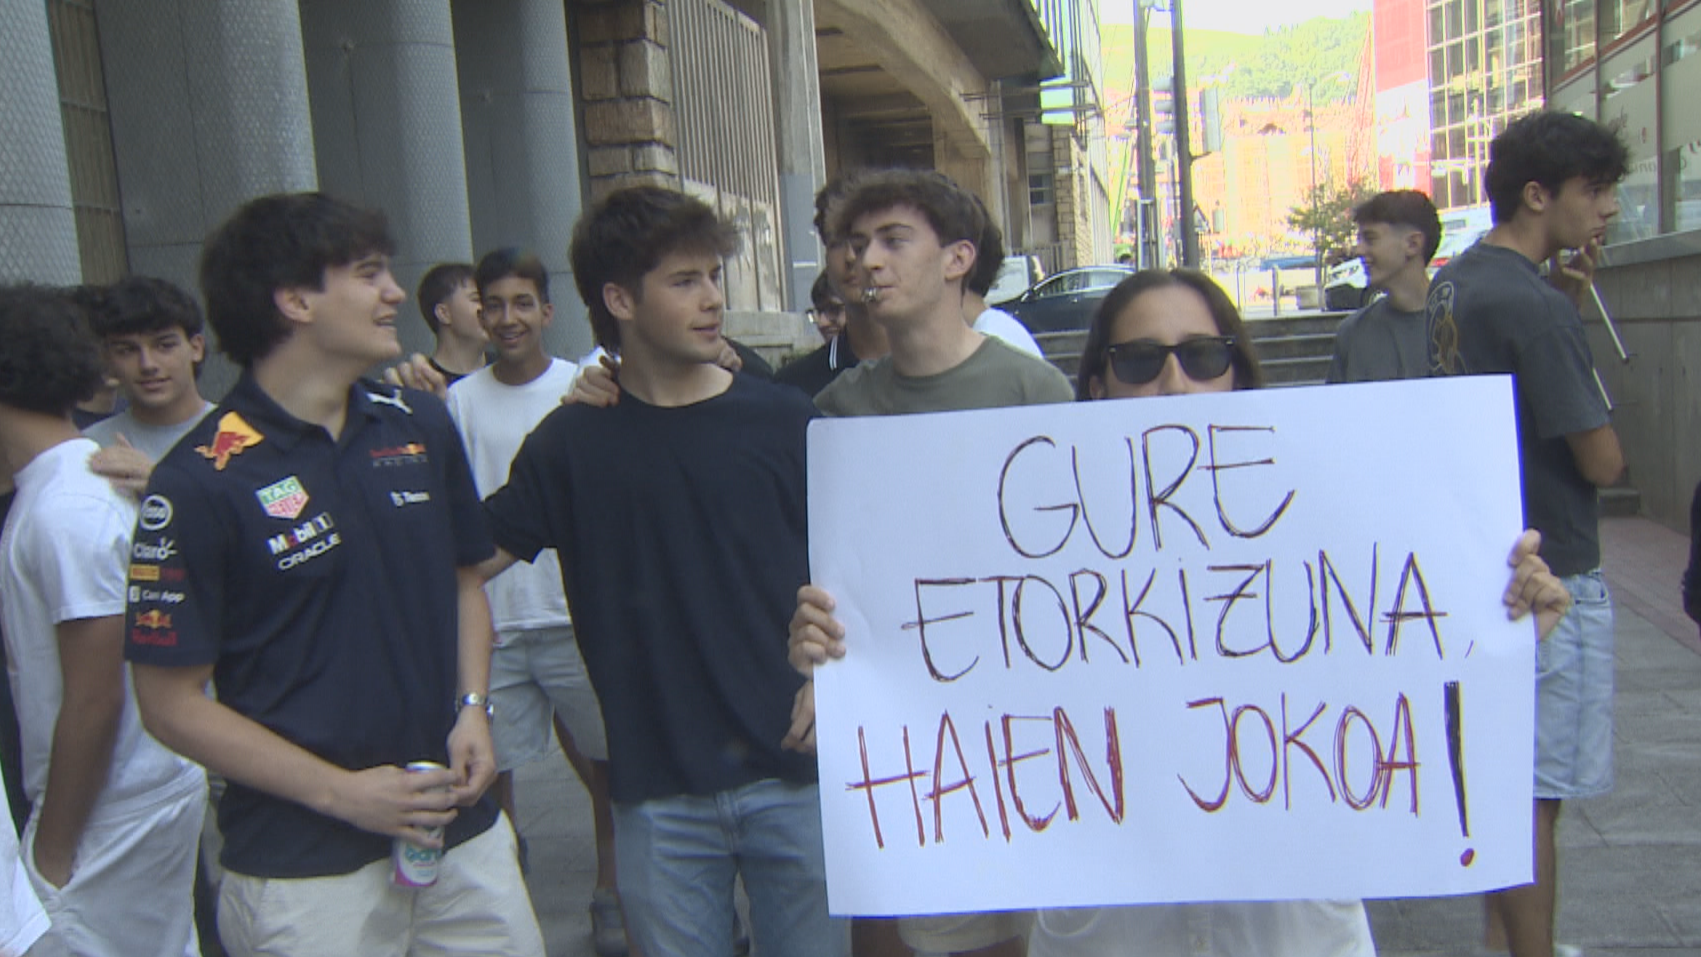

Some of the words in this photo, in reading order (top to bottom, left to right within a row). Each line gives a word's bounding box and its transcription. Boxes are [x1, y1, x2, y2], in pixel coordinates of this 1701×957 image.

[260, 480, 299, 505] TAG
[997, 424, 1295, 560] GURE
[133, 540, 173, 560] Claro
[268, 521, 318, 555] Mobil
[279, 532, 341, 570] ORACLE
[845, 704, 1124, 849] HAIEN
[1177, 680, 1476, 867] JOKOA!
